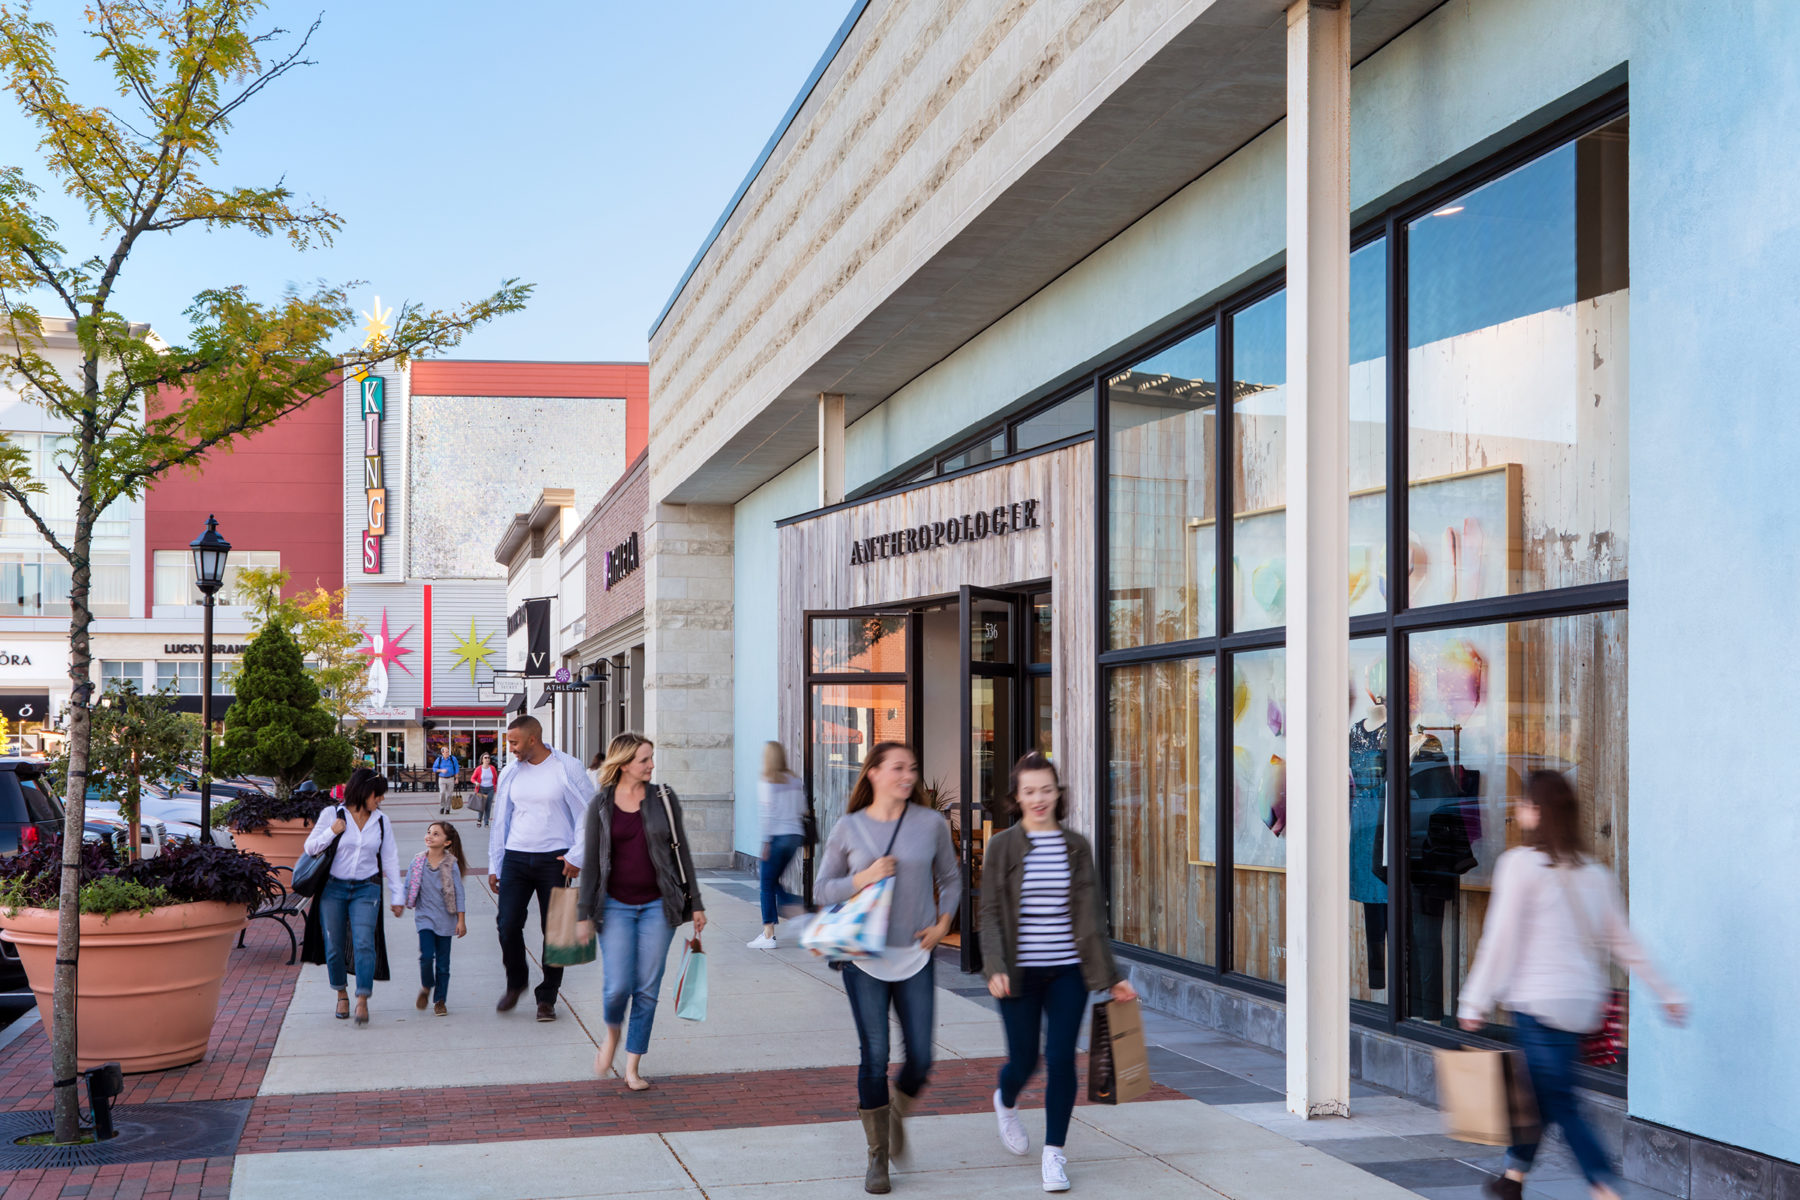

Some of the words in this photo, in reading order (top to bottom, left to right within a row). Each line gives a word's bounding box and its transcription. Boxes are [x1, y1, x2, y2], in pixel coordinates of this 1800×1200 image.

[363, 380, 384, 570] KINGS
[849, 498, 1041, 566] ANTHROPOLOGIE
[985, 622, 998, 639] 536
[164, 644, 205, 654] LUCKY
[530, 652, 546, 669] V
